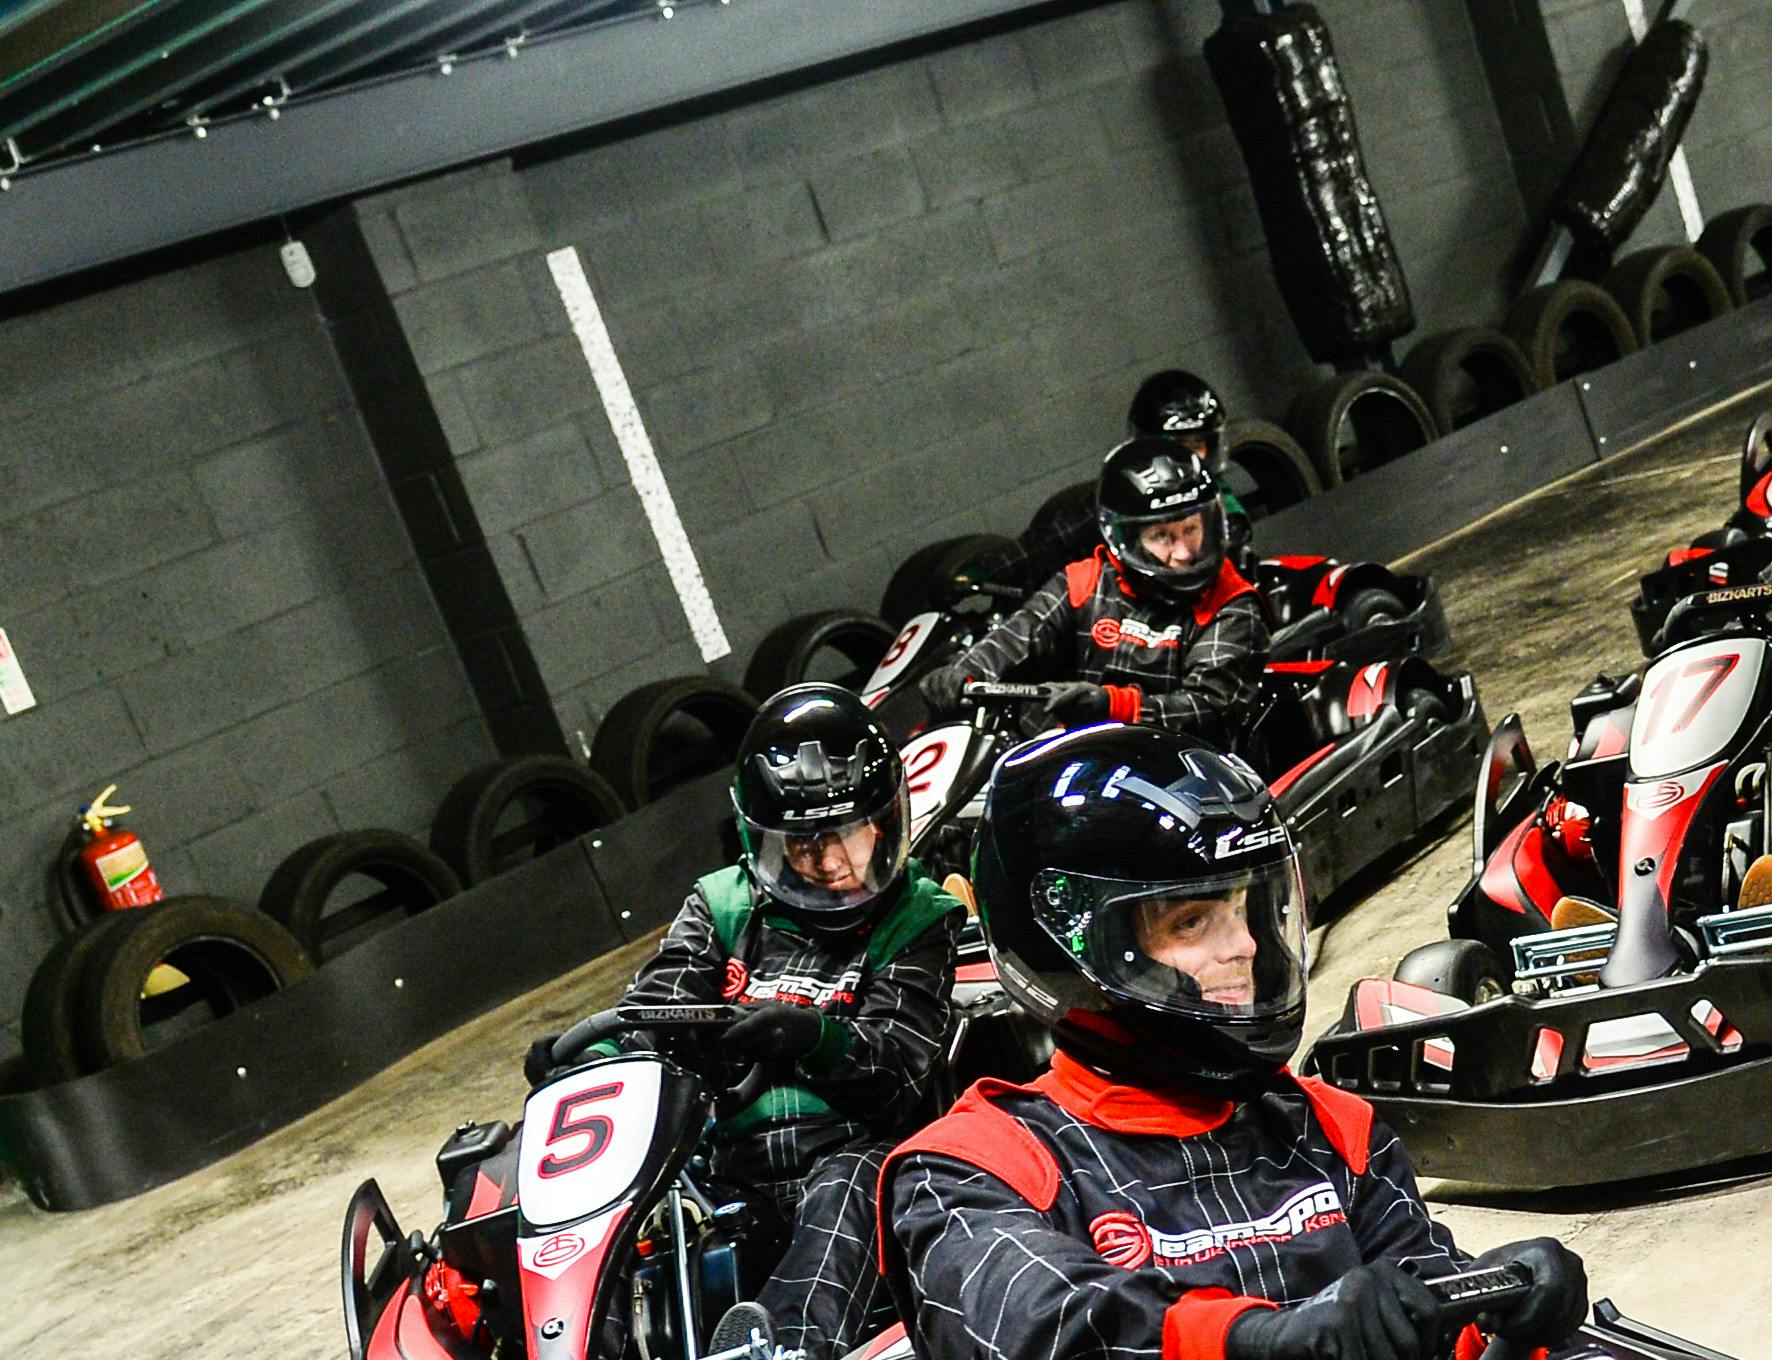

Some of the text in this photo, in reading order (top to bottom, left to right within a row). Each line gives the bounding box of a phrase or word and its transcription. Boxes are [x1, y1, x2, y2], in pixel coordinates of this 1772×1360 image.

[1707, 584, 1772, 604] BIZKARTS
[1642, 653, 1740, 746] 17
[783, 801, 855, 820] LS2
[1215, 828, 1287, 859] LS2
[1004, 962, 1059, 1010] S2
[537, 1081, 624, 1179] 5
[1147, 1181, 1342, 1258] TeamSpo
